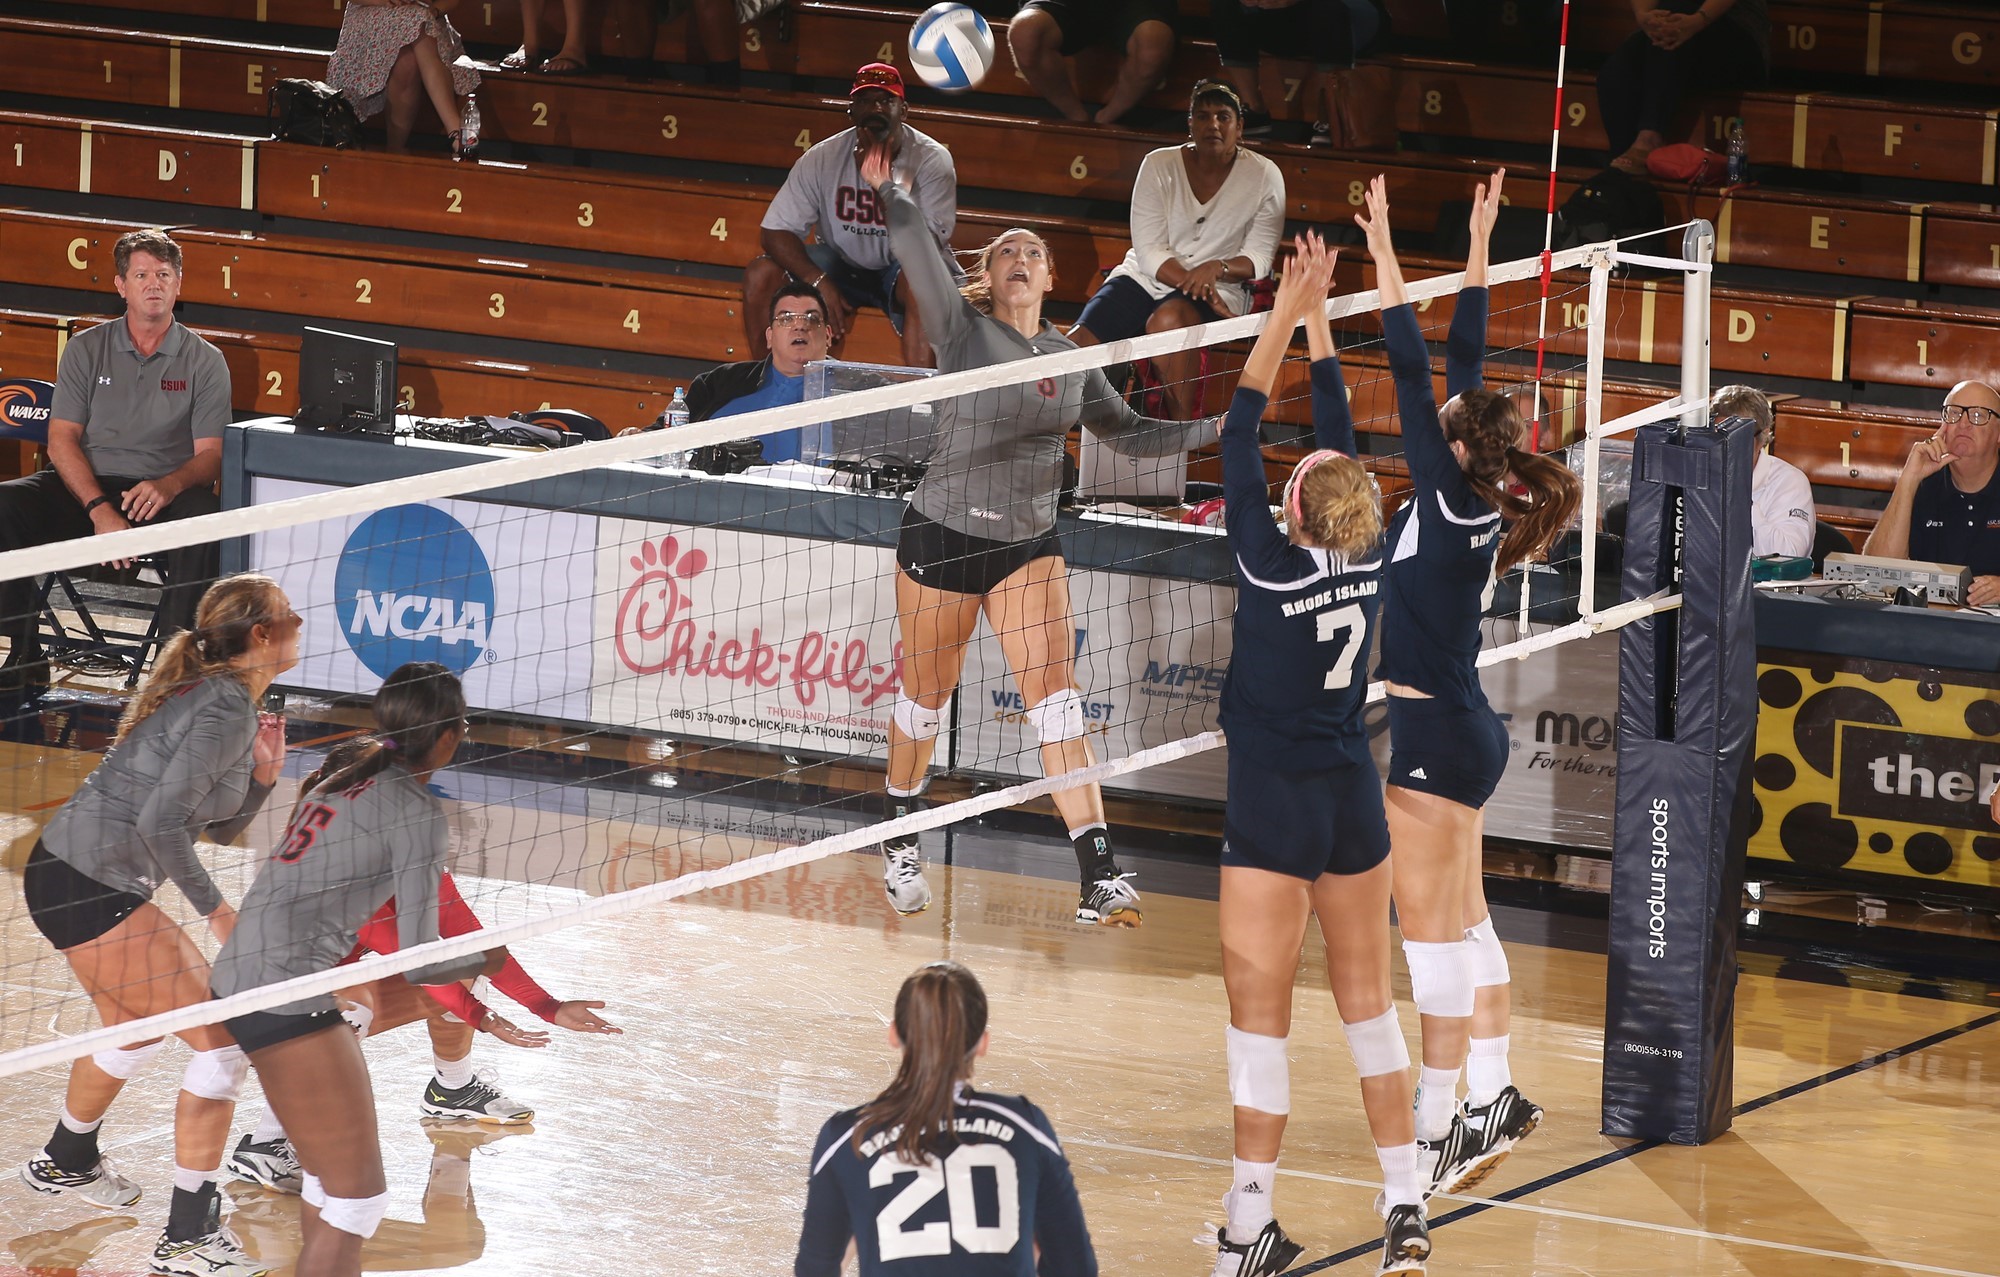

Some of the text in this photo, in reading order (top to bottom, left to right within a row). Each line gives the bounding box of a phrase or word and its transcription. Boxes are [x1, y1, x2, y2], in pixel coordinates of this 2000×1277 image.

[482, 3, 492, 26] 1
[745, 28, 761, 52] 3
[1787, 24, 1817, 51] 10
[1951, 31, 1982, 65] G
[877, 42, 894, 64] 4
[103, 60, 112, 83] 1
[247, 64, 263, 95] E
[1284, 78, 1301, 102] 7
[1425, 90, 1441, 115] 8
[532, 102, 548, 126] 2
[661, 114, 678, 139] 3
[1567, 102, 1586, 127] 9
[795, 129, 811, 152] 4
[1884, 124, 1903, 157] F
[13, 143, 23, 167] 1
[158, 149, 177, 181] D
[1069, 155, 1088, 180] 6
[310, 174, 320, 198] 1
[1347, 180, 1364, 206] 8
[446, 188, 462, 213] 2
[836, 185, 887, 226] CSU
[577, 202, 594, 227] 3
[710, 217, 728, 242] 4
[1810, 215, 1830, 250] E
[67, 237, 88, 270] C
[221, 265, 231, 290] 1
[355, 278, 372, 304] 2
[488, 293, 505, 318] 3
[1562, 302, 1589, 330] 10
[623, 309, 641, 334] 4
[1728, 309, 1756, 343] D
[1916, 339, 1928, 366] 1
[161, 379, 187, 391] CSUN
[266, 370, 282, 396] 2
[399, 385, 416, 411] 3
[9, 404, 51, 421] WAVES
[1839, 440, 1850, 468] 1
[1281, 580, 1378, 618] RHODE ISLAND
[350, 588, 487, 649] NCAA
[1316, 602, 1367, 690] 7
[1141, 660, 1227, 691] MPS
[1140, 686, 1184, 700] Mountain
[670, 708, 695, 723] (805)
[696, 711, 741, 727] 379-0790
[766, 706, 825, 723] THOUSAND
[828, 712, 857, 727] OAKS
[1528, 751, 1561, 770] For
[1563, 755, 1596, 775] the
[271, 801, 337, 865] 15
[1646, 798, 1670, 959] sports imports
[1623, 1042, 1683, 1060] (800)556-3198
[869, 1143, 1020, 1263] 20
